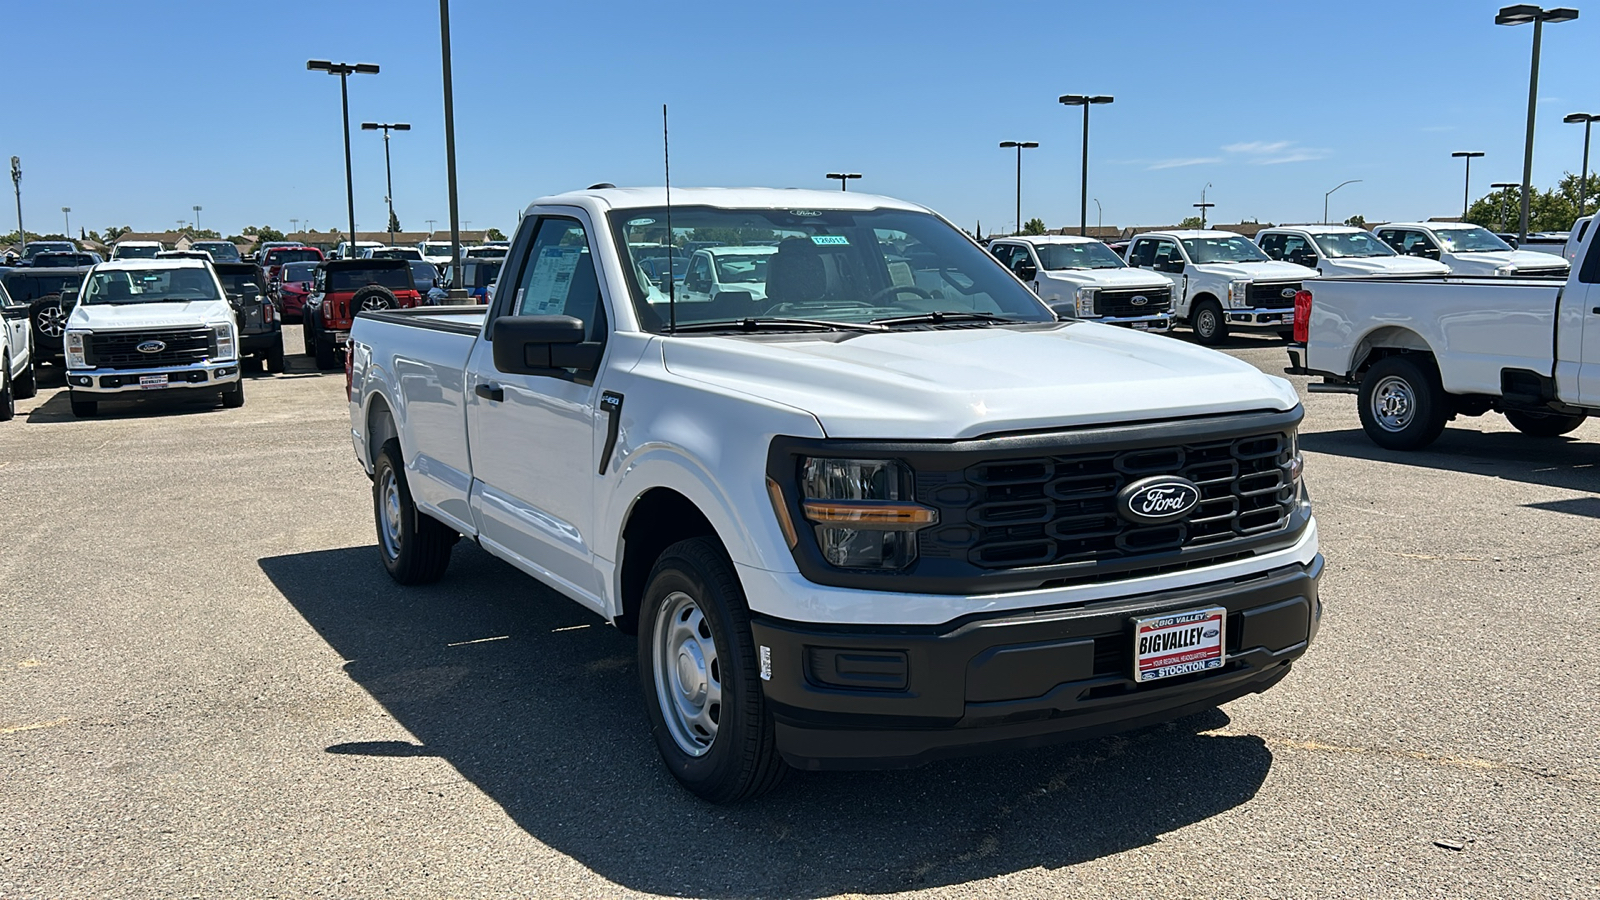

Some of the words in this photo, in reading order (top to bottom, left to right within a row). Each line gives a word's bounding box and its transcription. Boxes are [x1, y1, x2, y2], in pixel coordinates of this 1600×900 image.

[1142, 488, 1186, 513] Ford
[1158, 618, 1174, 627] BIG
[1176, 613, 1205, 624] VALLEY
[1139, 626, 1204, 655] BIGVALLEY
[1153, 659, 1163, 667] YOUR
[1163, 656, 1180, 665] REGIONAL
[1180, 651, 1207, 662] HEADQUARTERS
[1158, 660, 1206, 677] STOCKTON
